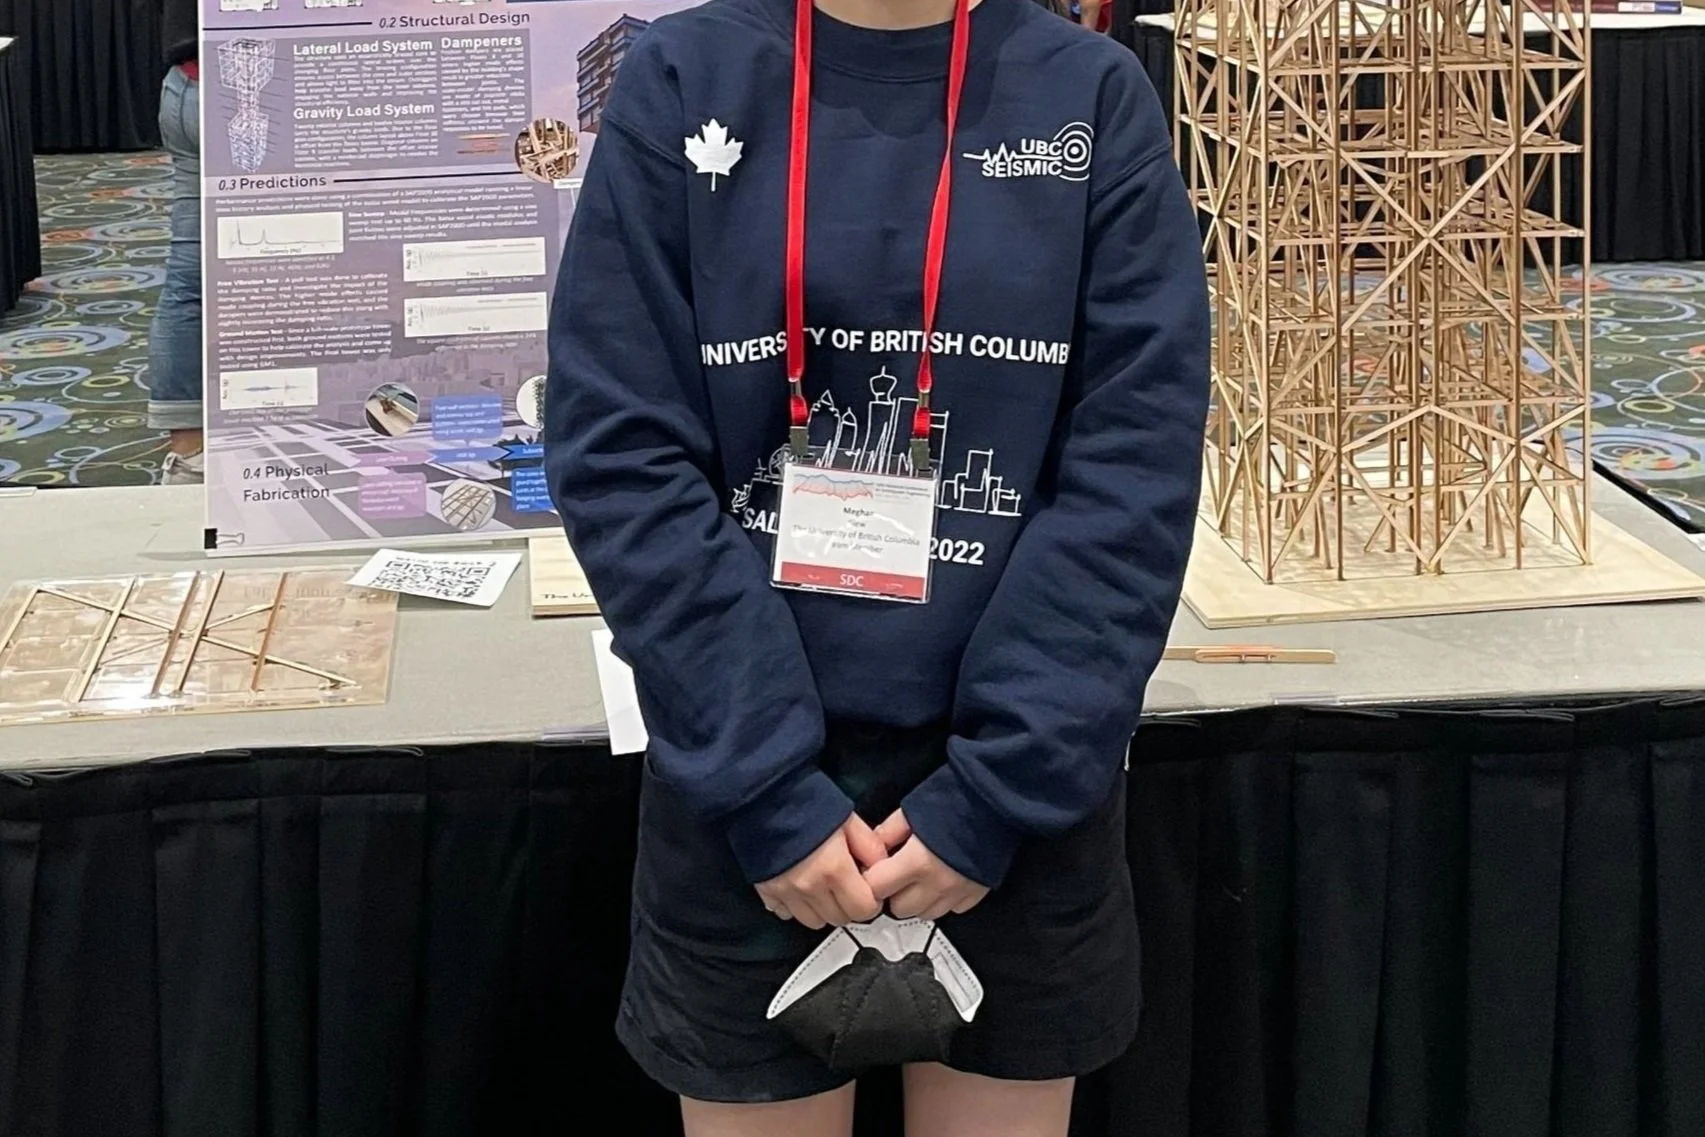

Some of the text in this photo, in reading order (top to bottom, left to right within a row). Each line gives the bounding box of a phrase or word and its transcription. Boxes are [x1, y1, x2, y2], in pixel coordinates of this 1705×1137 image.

[379, 11, 530, 29] 0.2 Structural Design
[293, 40, 433, 56] Lateral Load System
[441, 37, 522, 50] Dampeners
[293, 103, 435, 121] Gravity Load System
[1021, 138, 1062, 156] UBC
[982, 159, 1062, 178] SEISMIC
[218, 176, 327, 191] 0.3 Predictions
[701, 327, 826, 366] NIVERSY
[831, 328, 865, 352] OF
[870, 330, 964, 355] BRITISH
[243, 463, 329, 480] 0.4 Physical
[243, 487, 330, 502] Fabrication
[848, 530, 857, 539] of
[858, 531, 882, 542] British
[884, 535, 920, 547] Columbia
[929, 537, 985, 566] 2022
[840, 573, 864, 587] SDC
